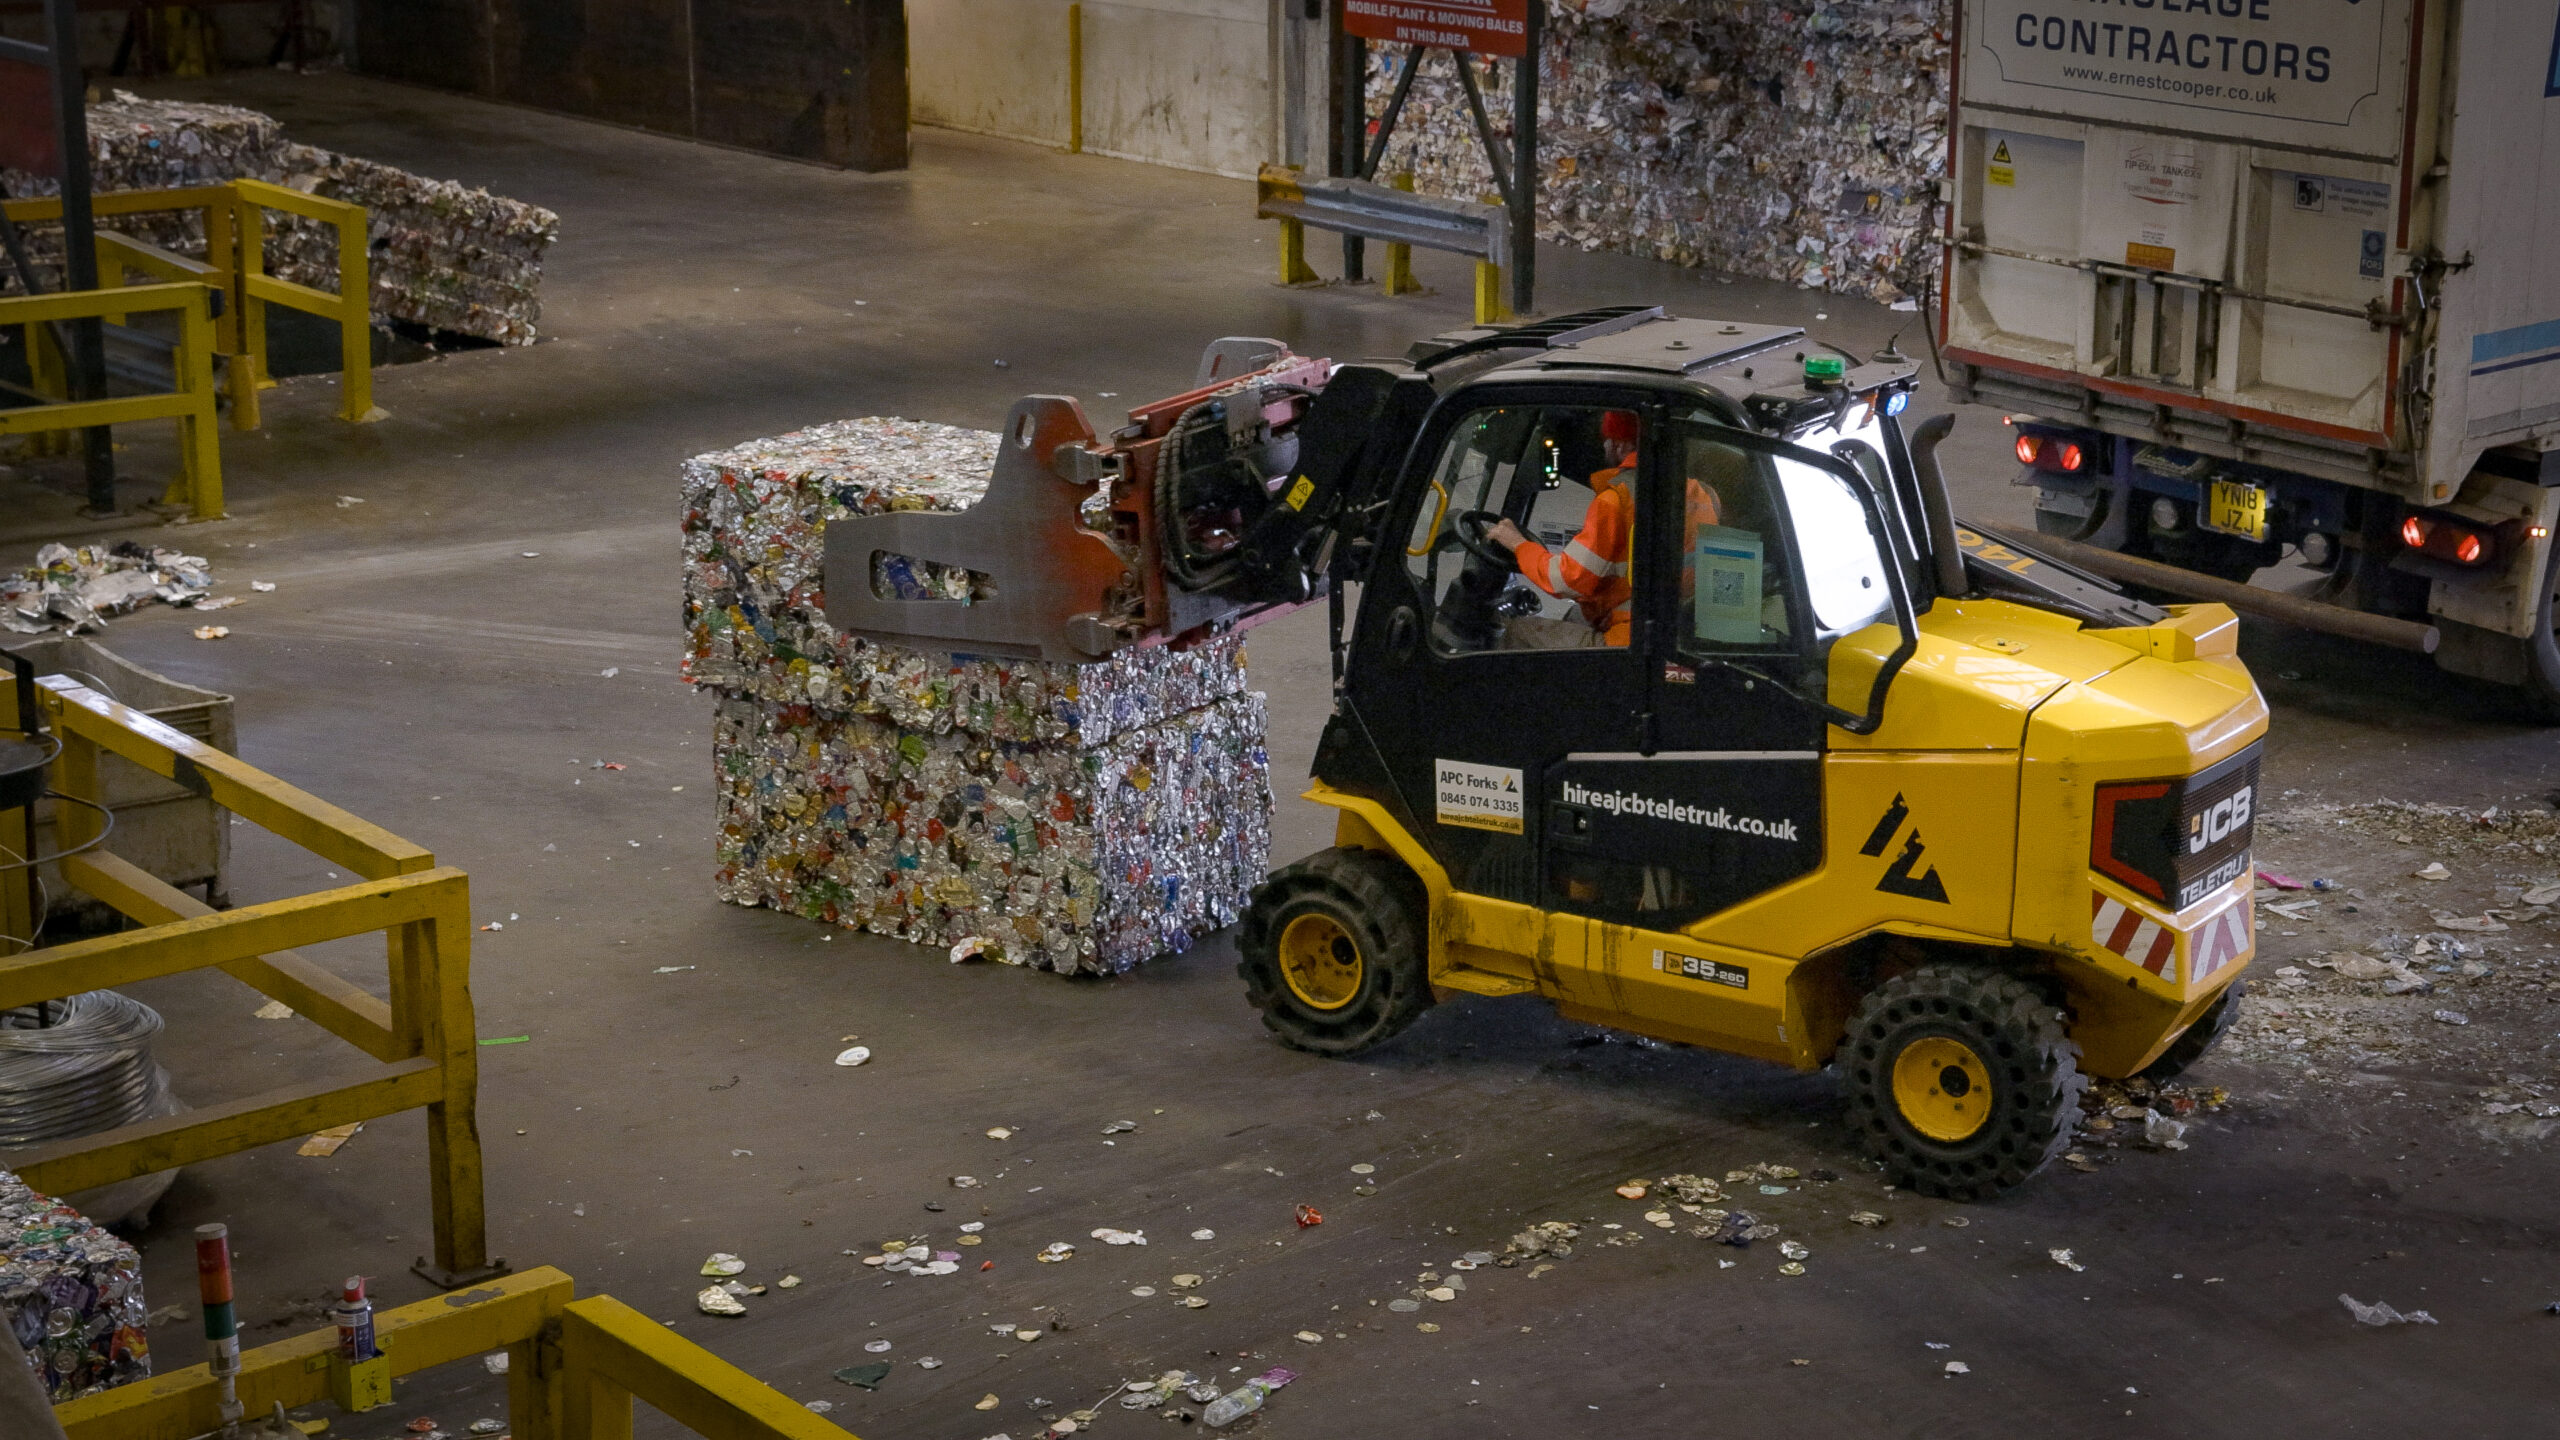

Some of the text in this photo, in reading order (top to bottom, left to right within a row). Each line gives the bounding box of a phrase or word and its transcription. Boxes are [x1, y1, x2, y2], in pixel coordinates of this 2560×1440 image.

[1347, 2, 1524, 35] MOBILE PLANT & MOVING BALES
[1396, 27, 1470, 48] IN THIS AREA
[2015, 13, 2331, 83] CONTRACTORS
[2062, 65, 2277, 104] www.ernestcooper.co.uk
[1440, 770, 1498, 791] APC Forks
[1440, 791, 1519, 813] 0845 074 3335
[1563, 781, 1798, 841] hireajcbteletruk.co.uk
[2190, 786, 2251, 853] JCB
